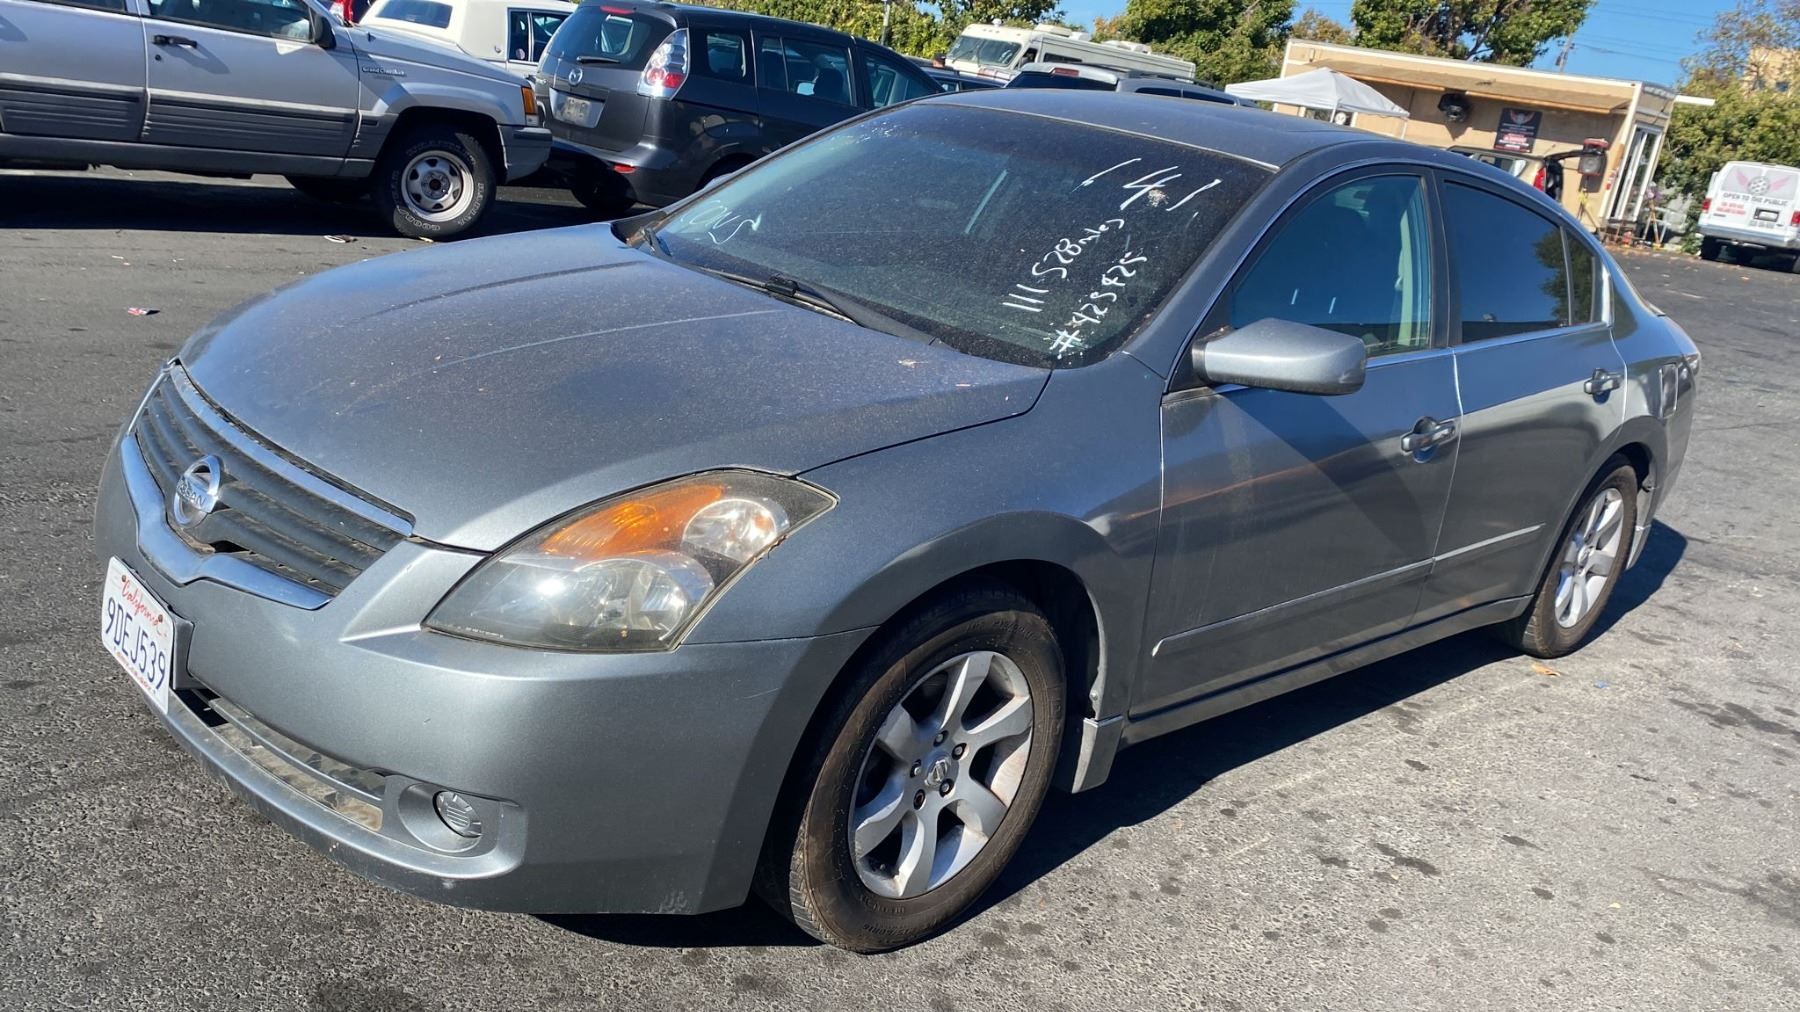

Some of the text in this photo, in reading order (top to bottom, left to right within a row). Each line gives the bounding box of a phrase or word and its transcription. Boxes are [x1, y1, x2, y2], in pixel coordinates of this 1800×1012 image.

[1723, 192, 1740, 200] OPEN
[1764, 198, 1789, 206] PUBLIC
[121, 583, 160, 627] California
[104, 596, 167, 691] 9DEJ539
